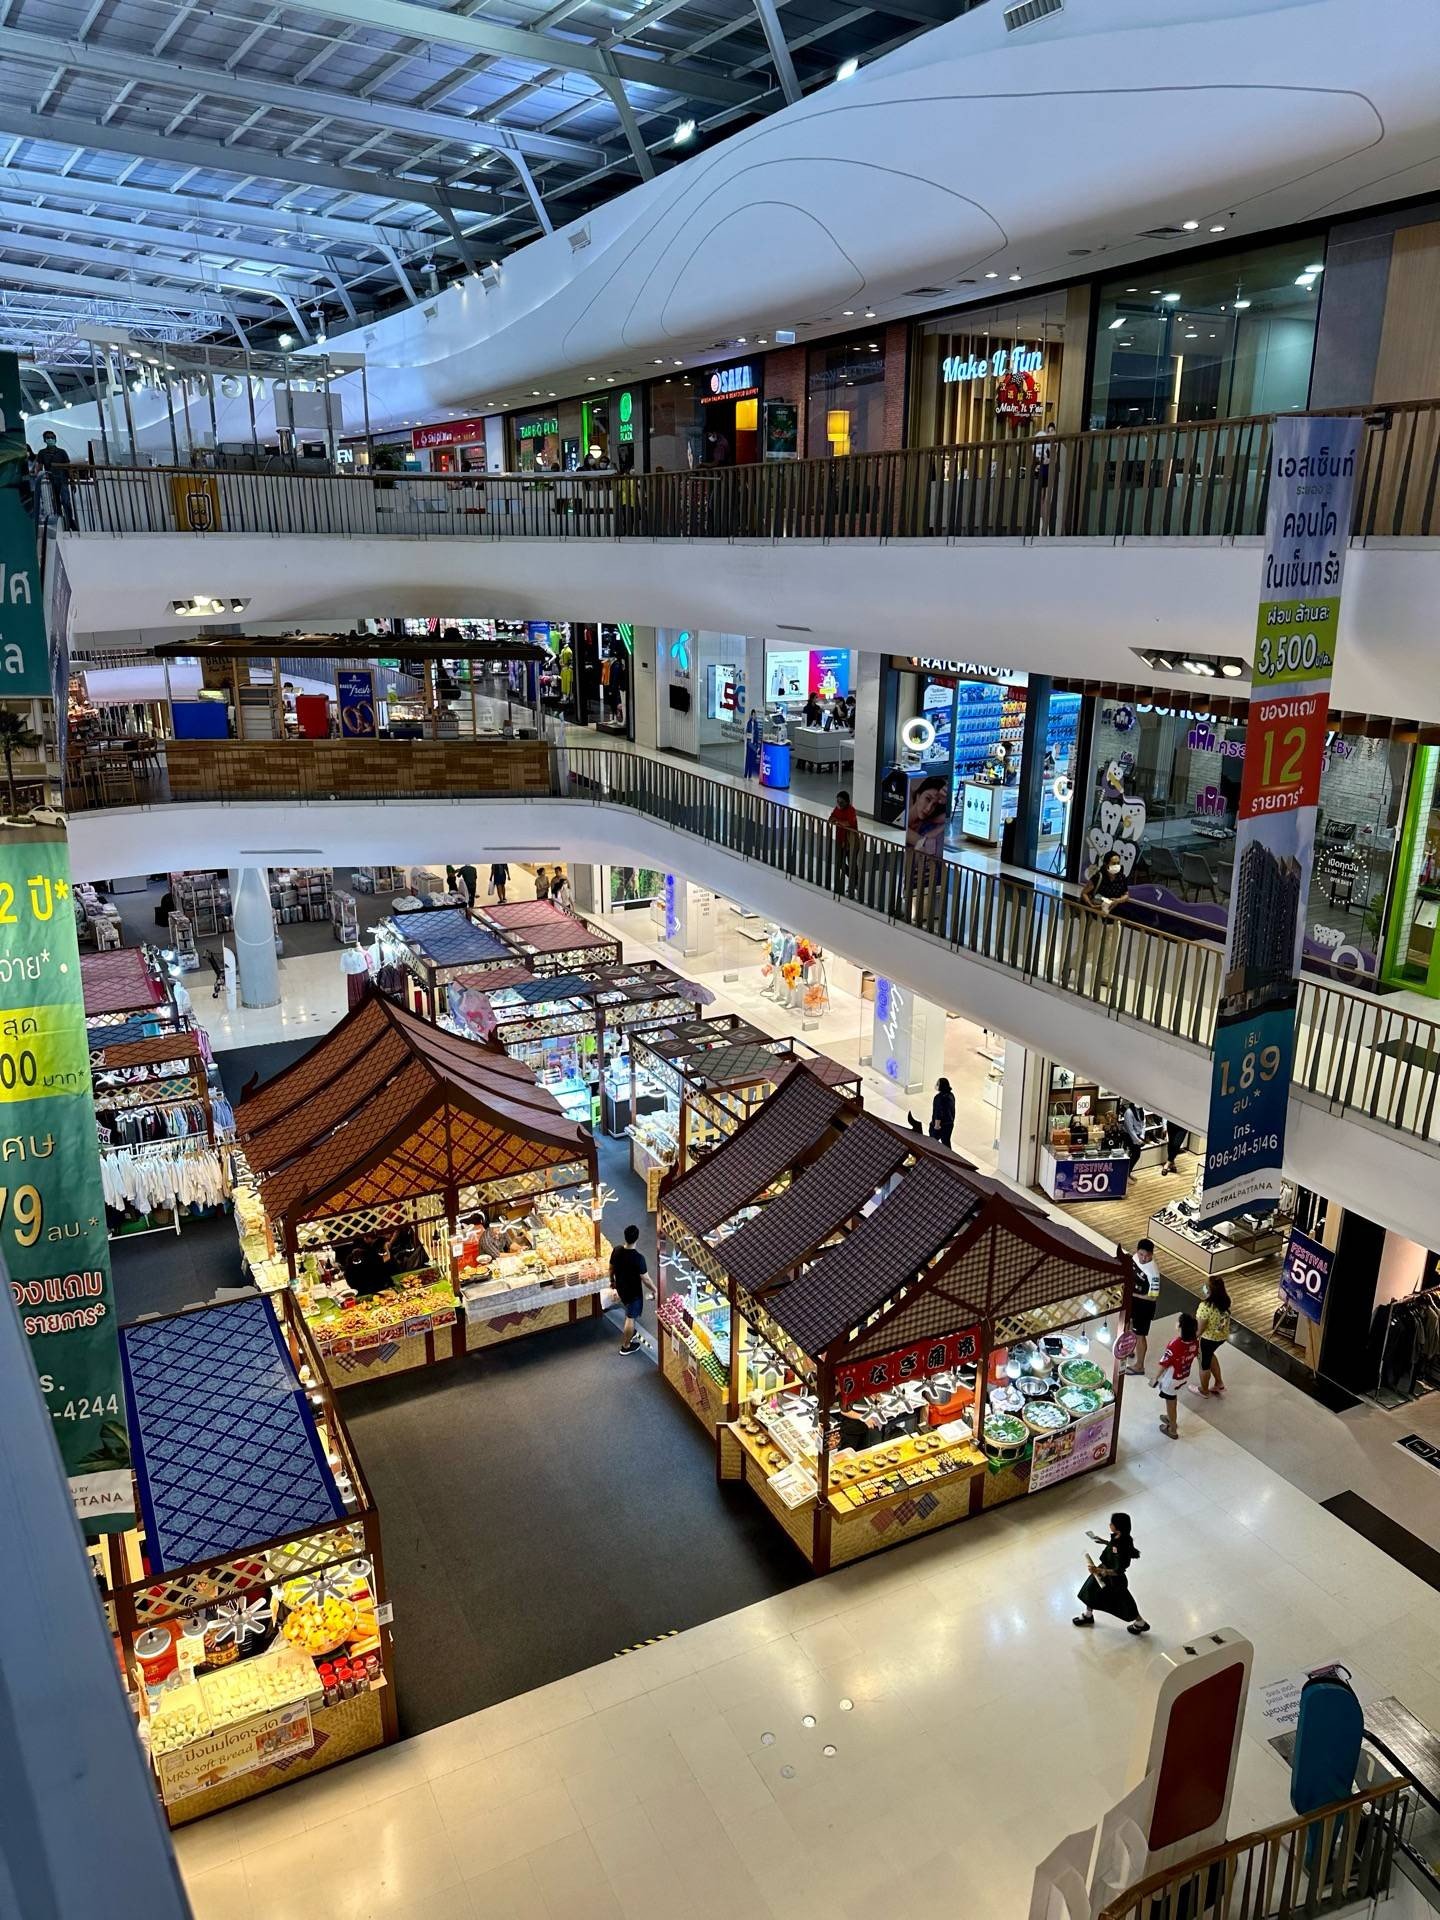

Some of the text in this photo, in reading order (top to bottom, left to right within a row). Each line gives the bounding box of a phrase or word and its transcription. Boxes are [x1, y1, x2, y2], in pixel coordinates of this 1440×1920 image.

[943, 354, 987, 382] Make
[1011, 345, 1042, 374] Fun
[1283, 502, 1337, 538] คอนโด
[1267, 548, 1339, 588] ในเซ็นทรัล
[1259, 633, 1317, 676] 3,500
[1260, 699, 1317, 722] ของแถม
[1262, 727, 1306, 785] 12
[0, 882, 17, 923] 2
[4, 1017, 37, 1041] สุด
[1220, 1045, 1281, 1097] 1.89
[1073, 1162, 1114, 1173] FESTIVAL
[1209, 1134, 1278, 1170] 096-214-5146
[1077, 1173, 1109, 1193] 50
[1290, 1242, 1328, 1275] FESTIVAL
[1290, 1258, 1322, 1293] 50
[46, 1393, 119, 1421] -4244
[219, 1743, 255, 1765] Bread
